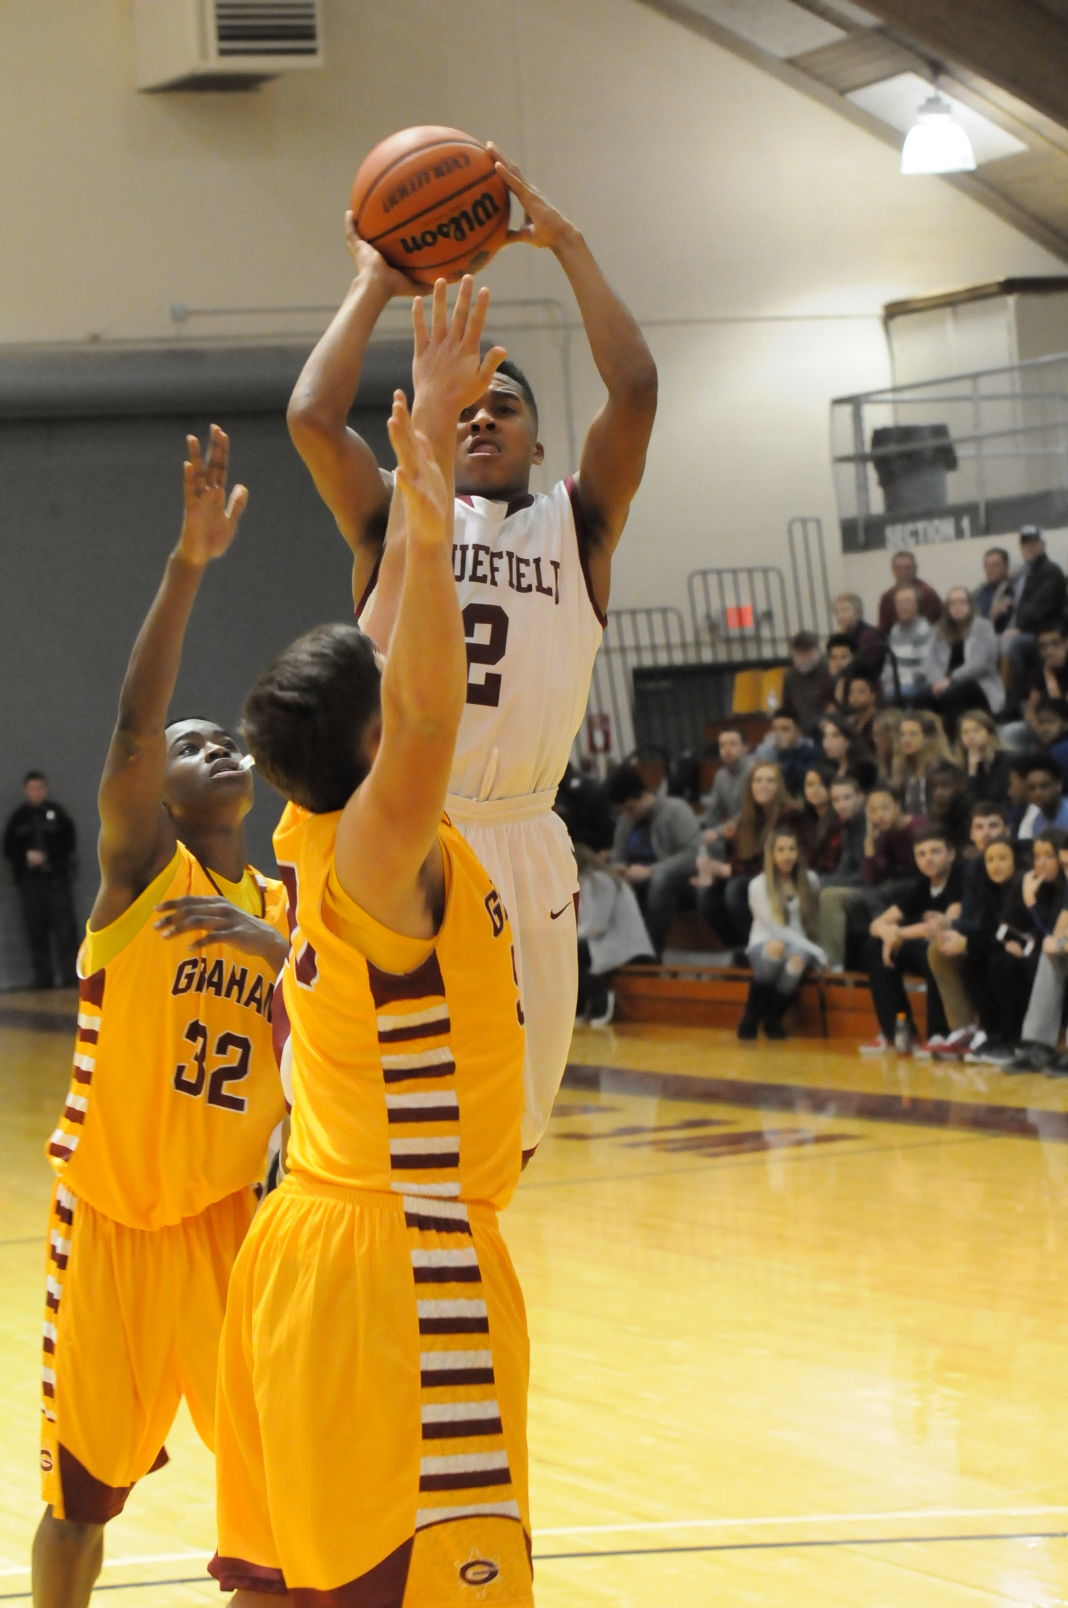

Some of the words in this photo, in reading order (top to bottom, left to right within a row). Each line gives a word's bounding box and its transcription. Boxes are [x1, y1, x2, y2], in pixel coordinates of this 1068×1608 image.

[400, 192, 500, 253] Wilson
[885, 516, 956, 550] SECTION
[962, 514, 972, 540] 1
[452, 544, 560, 605] UEFIEL
[461, 603, 509, 707] 2
[173, 1018, 252, 1113] 32
